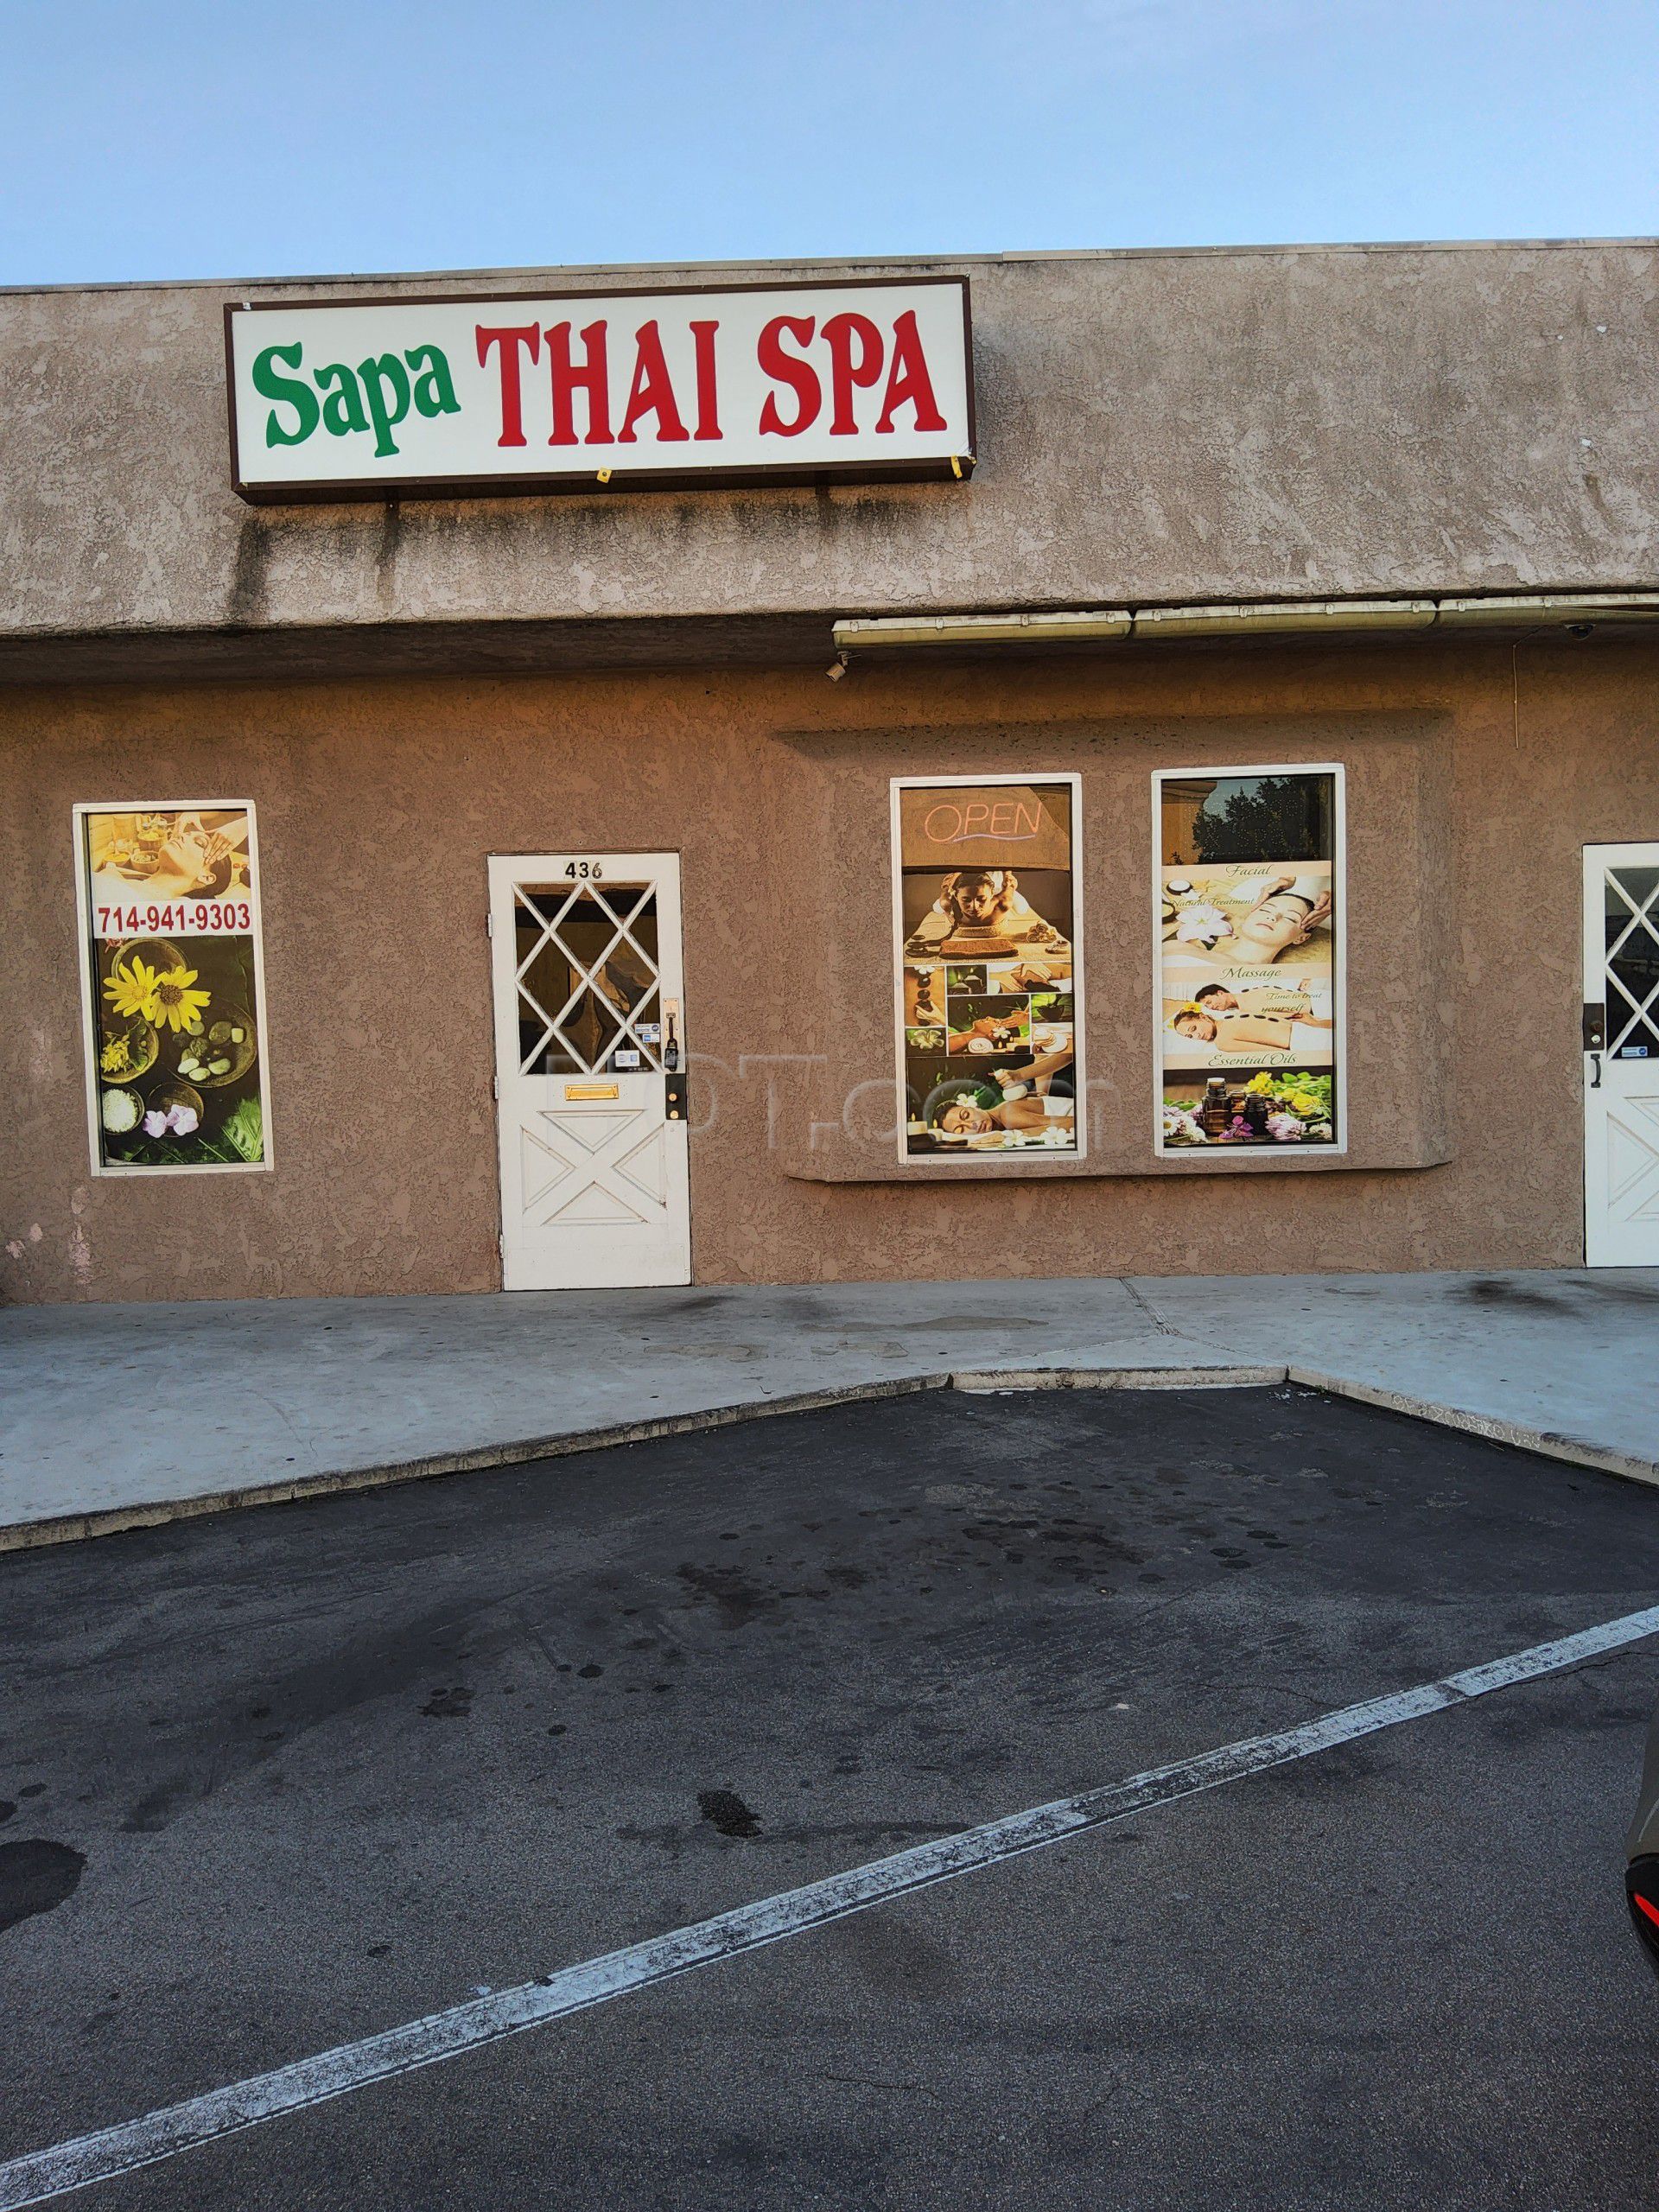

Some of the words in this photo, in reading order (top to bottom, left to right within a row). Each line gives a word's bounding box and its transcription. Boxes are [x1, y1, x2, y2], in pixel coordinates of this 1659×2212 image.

[251, 340, 461, 459] Sapa
[475, 319, 724, 448] THAI
[757, 309, 948, 438] SPA
[925, 802, 1043, 842] OPEN
[564, 861, 603, 880] 436
[1225, 864, 1273, 878] Facial
[1172, 899, 1207, 908] Natural
[1207, 898, 1255, 906] Treatment
[98, 903, 251, 933] 714-941-9303
[1219, 966, 1282, 982] Massage
[1266, 992, 1290, 1001] Time
[1261, 1003, 1306, 1014] yourself
[1207, 1053, 1270, 1067] Essential
[1269, 1052, 1298, 1066] Oils
